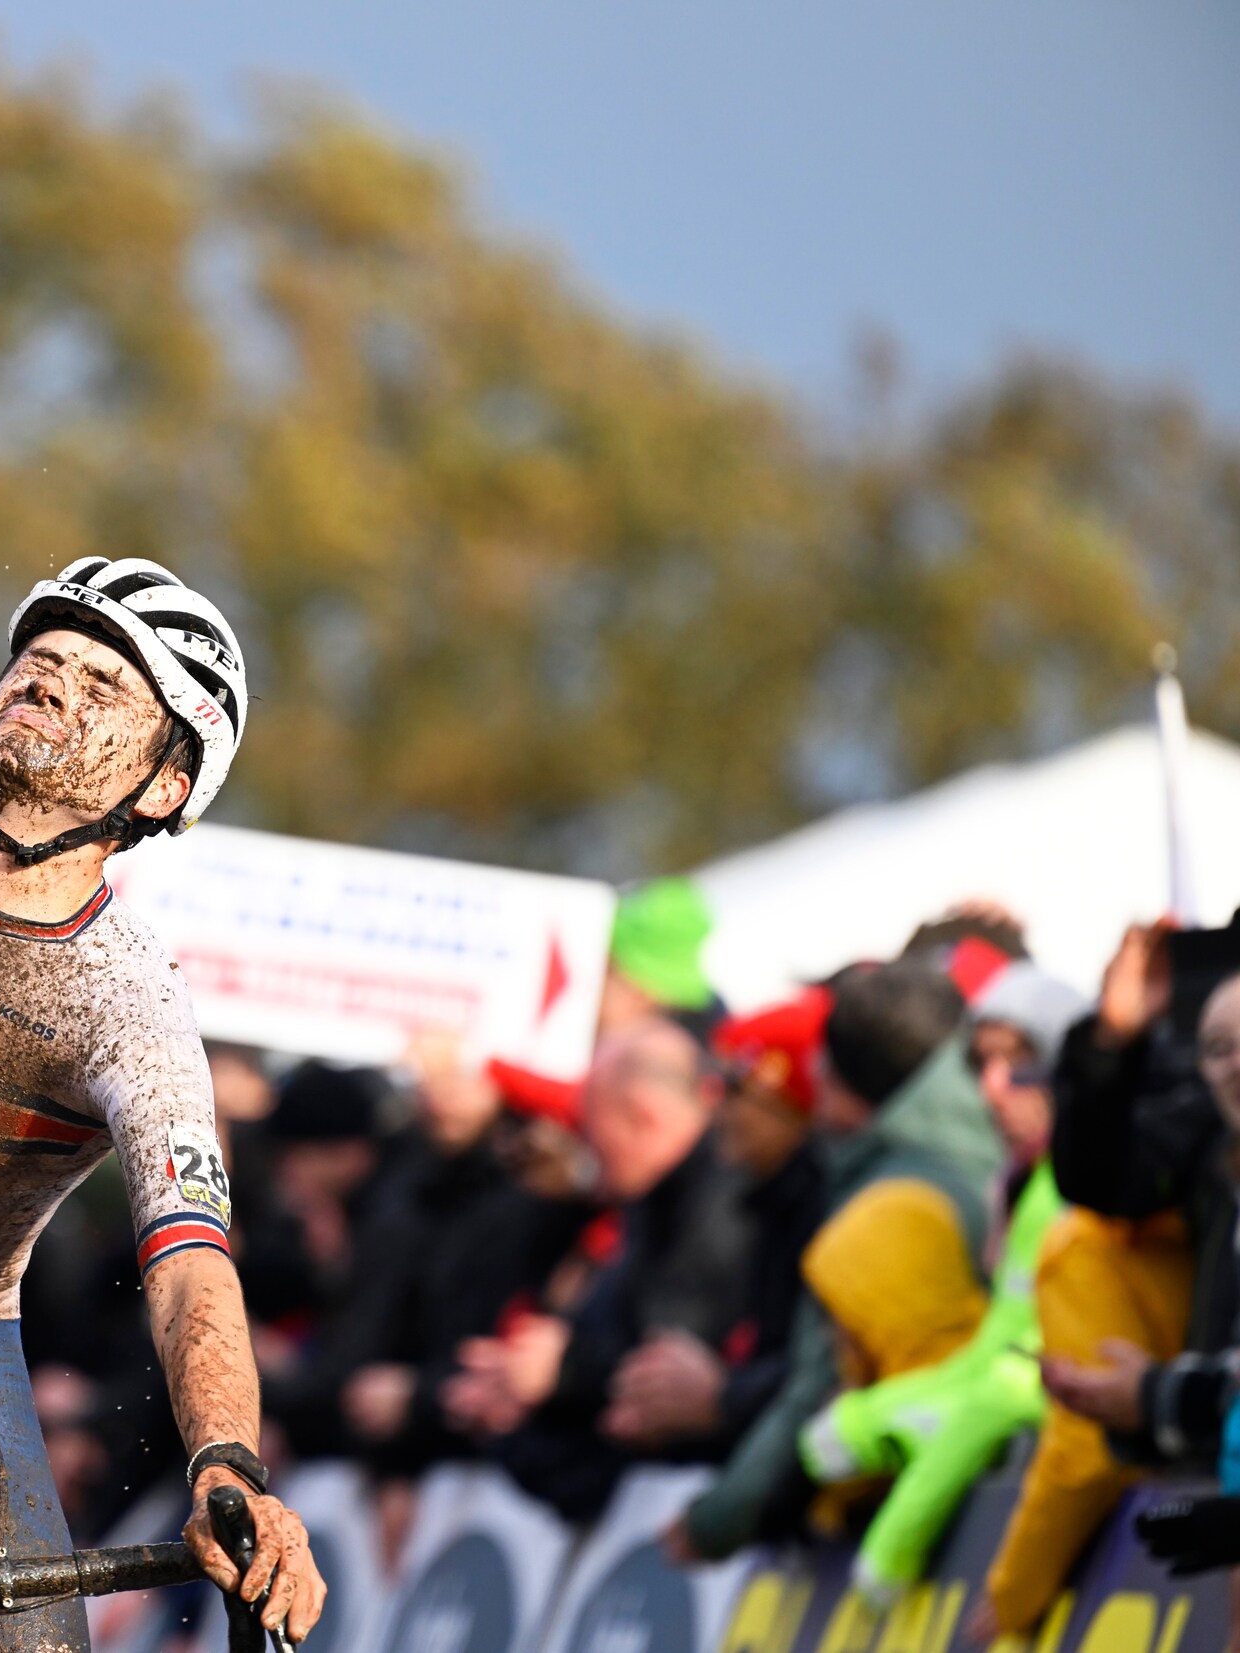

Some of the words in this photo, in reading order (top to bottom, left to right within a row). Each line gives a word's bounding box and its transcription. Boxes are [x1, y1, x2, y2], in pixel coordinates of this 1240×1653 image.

[59, 584, 109, 605] MET
[195, 698, 222, 725] 777
[174, 1145, 227, 1197] 28
